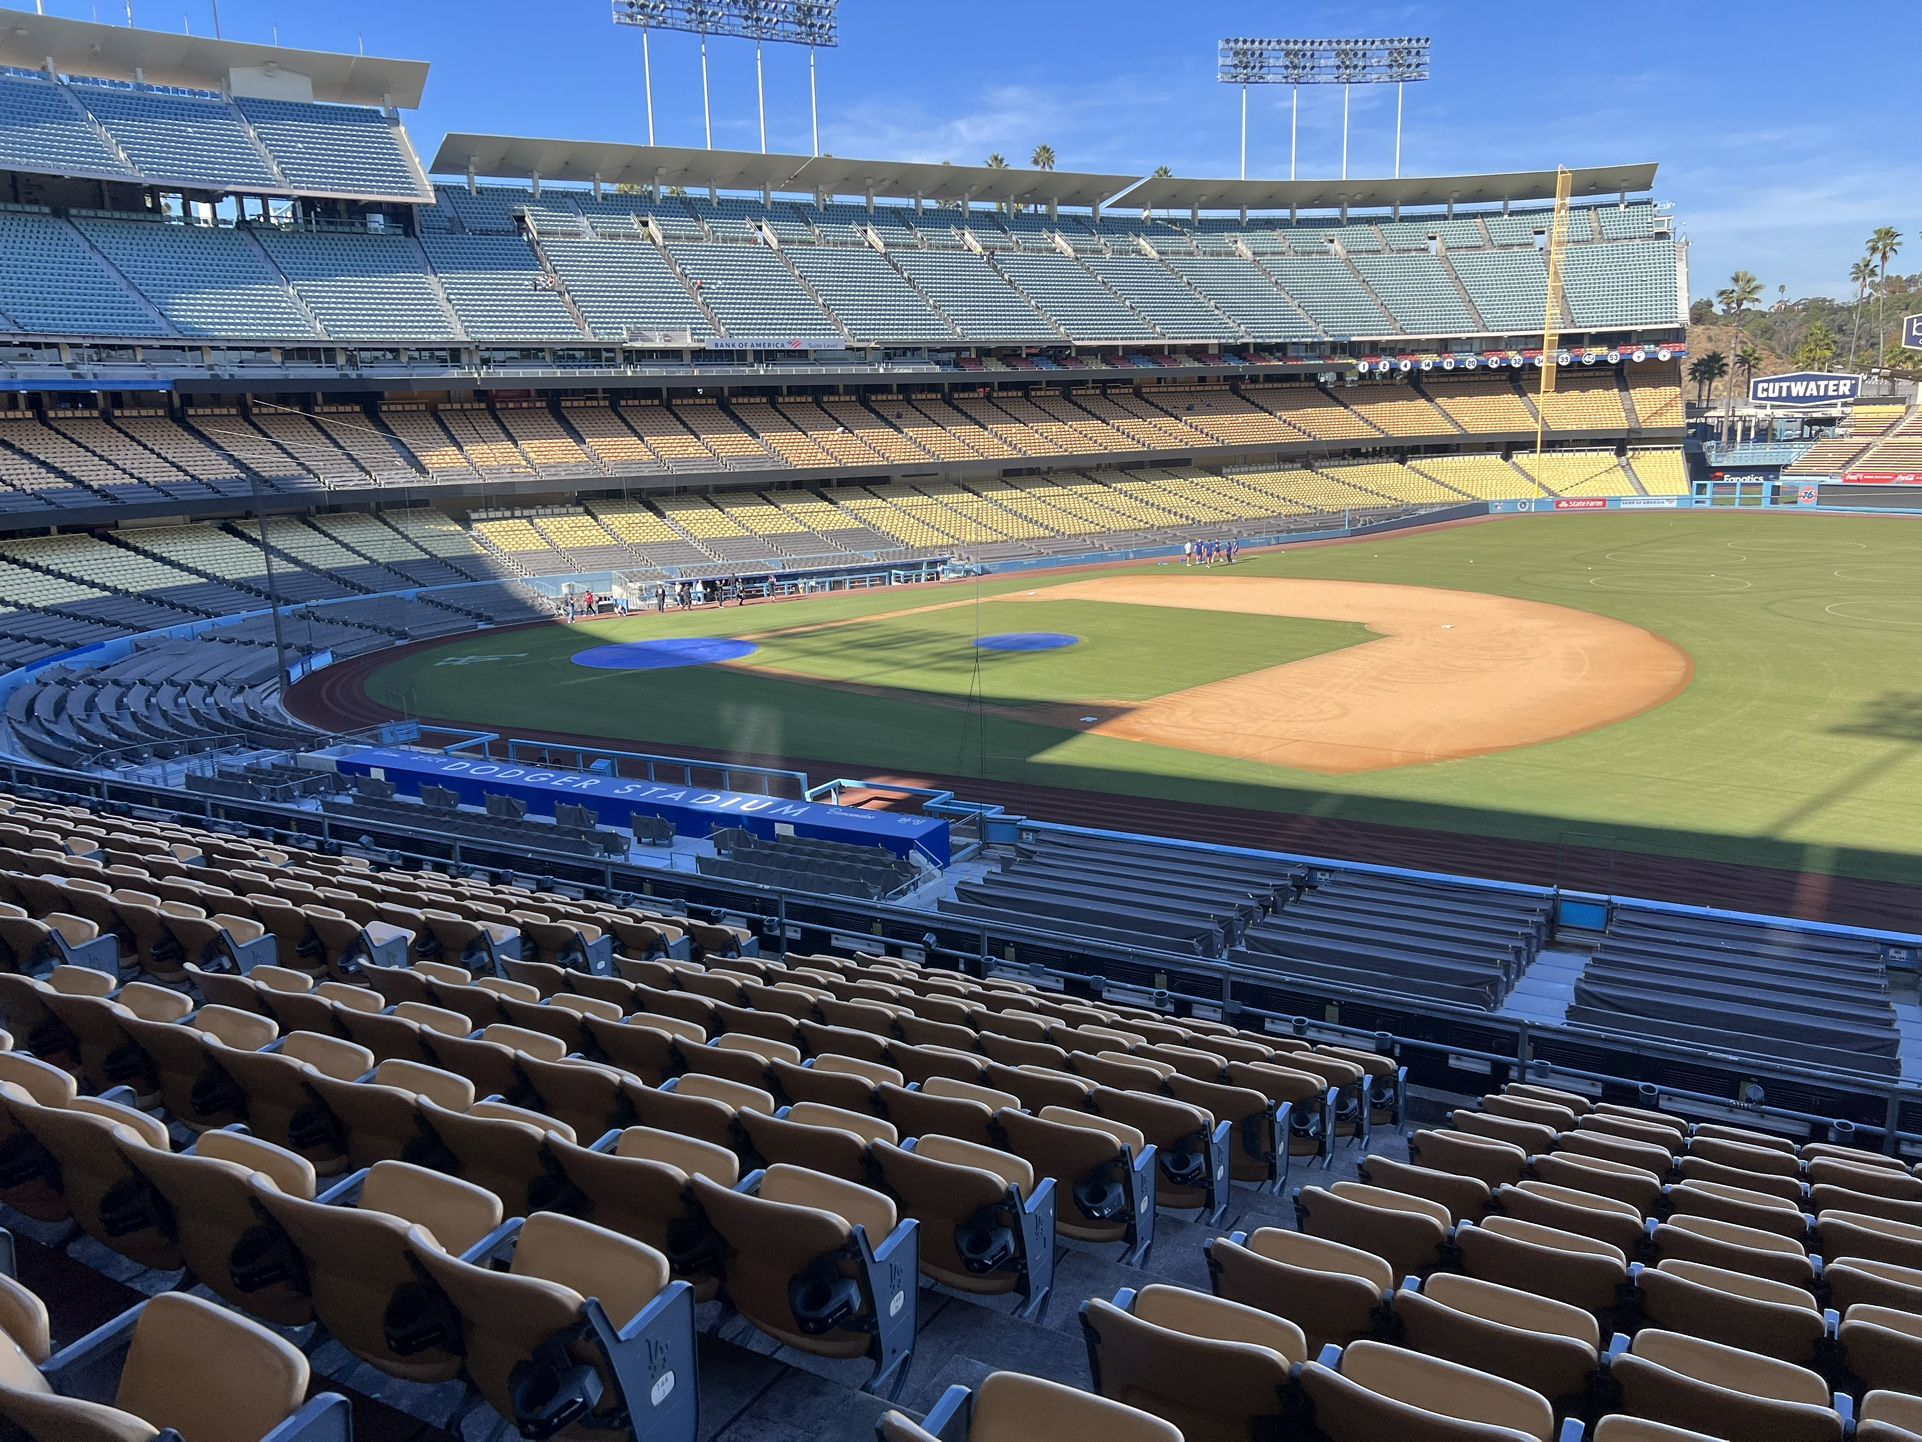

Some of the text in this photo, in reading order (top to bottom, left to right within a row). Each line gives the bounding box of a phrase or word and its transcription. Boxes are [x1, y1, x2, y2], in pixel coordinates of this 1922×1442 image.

[1467, 359, 1476, 367] 20
[1489, 358, 1498, 366] 24
[1512, 358, 1522, 366] 32
[1757, 380, 1851, 398] CUTWATER
[1723, 474, 1764, 482] Fanatics
[1802, 489, 1814, 499] 76
[441, 761, 601, 789] DODGER
[613, 784, 811, 817] STADIUM
